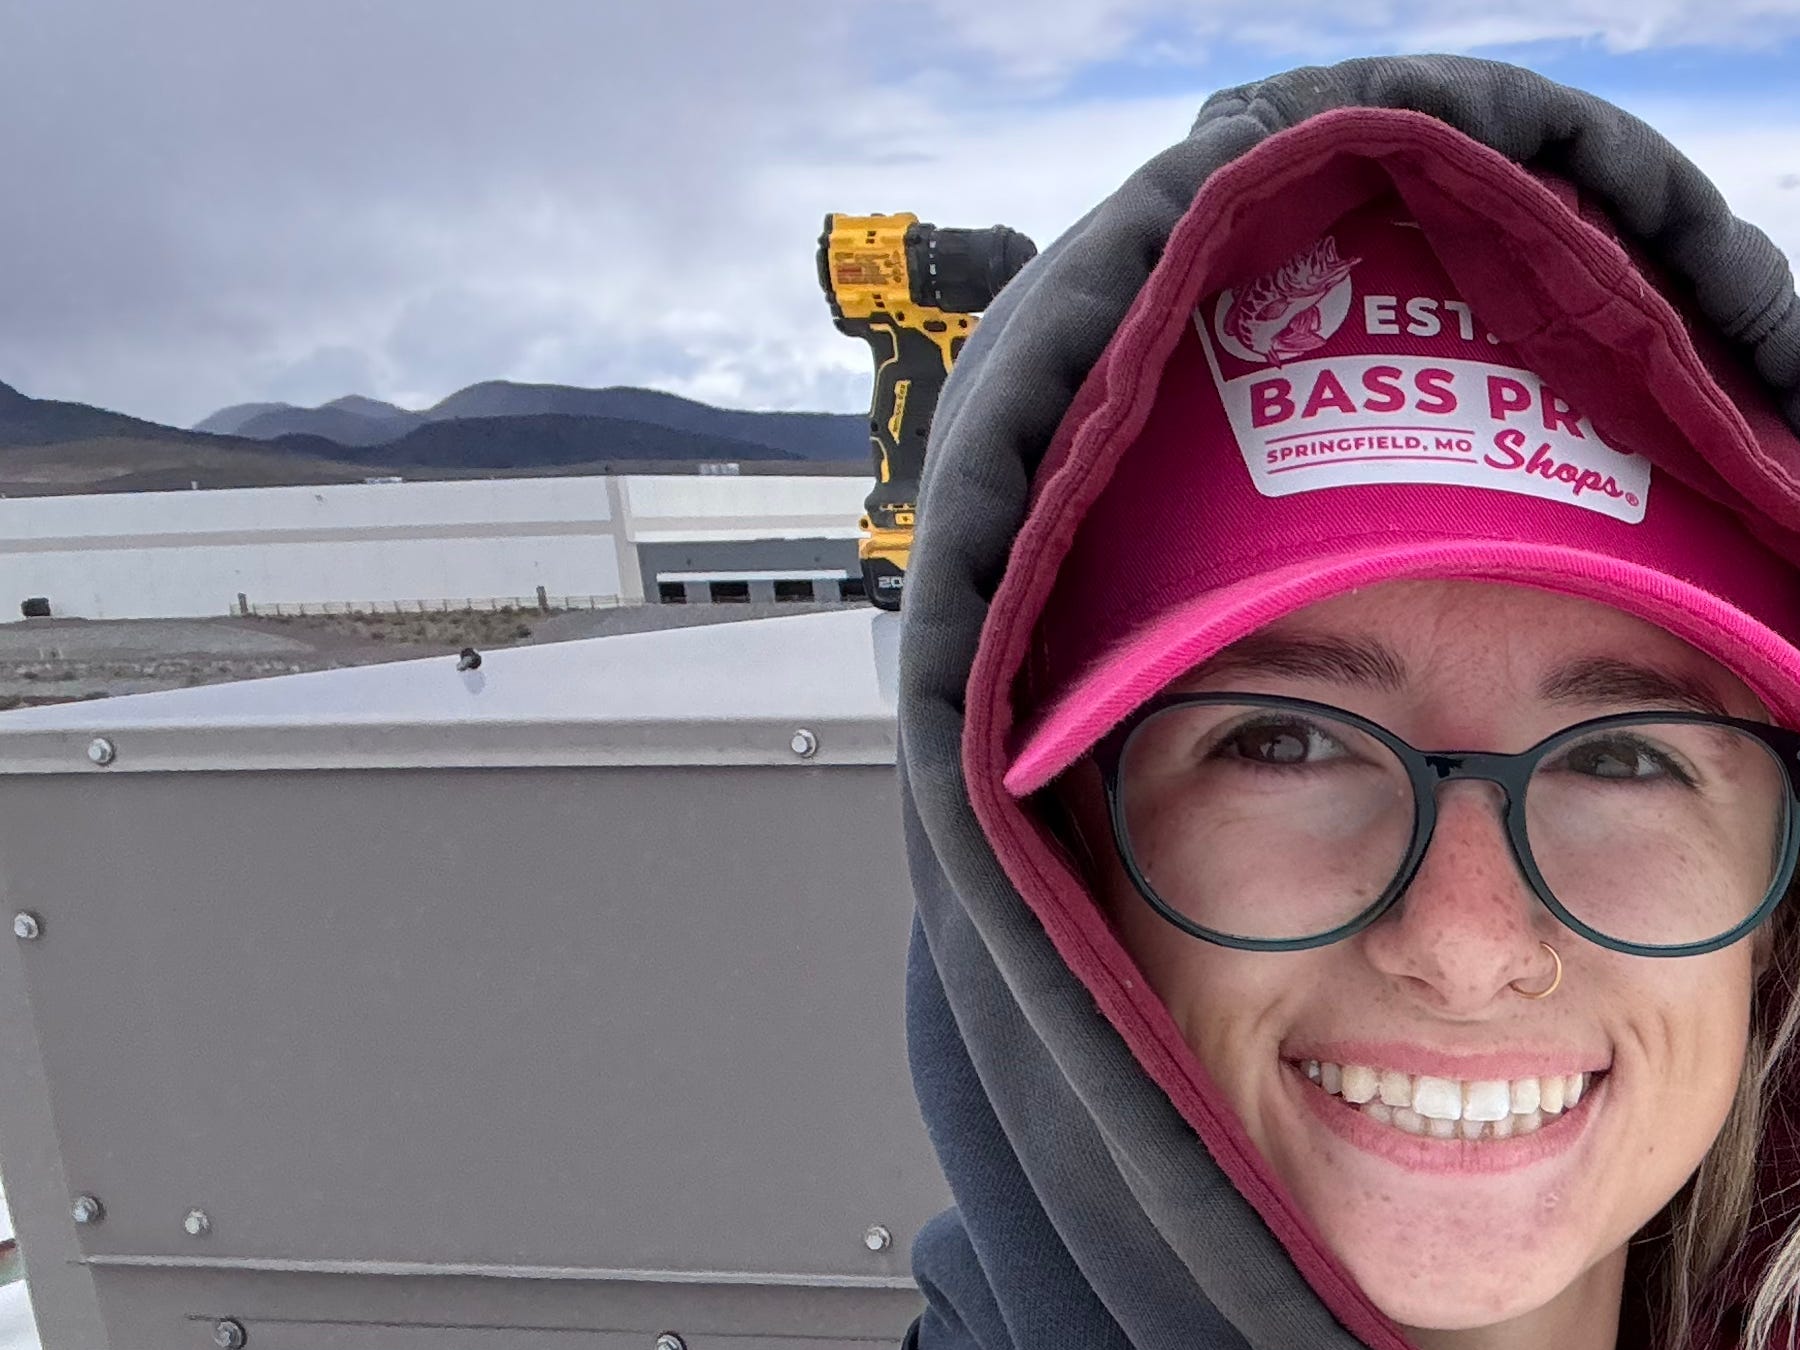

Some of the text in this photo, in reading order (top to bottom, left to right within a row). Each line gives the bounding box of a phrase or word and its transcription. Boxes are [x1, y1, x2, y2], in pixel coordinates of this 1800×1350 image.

[1364, 295, 1501, 343] EST.
[1250, 365, 1635, 455] BASS PR
[1266, 436, 1473, 463] SPRINGFIELD, MO
